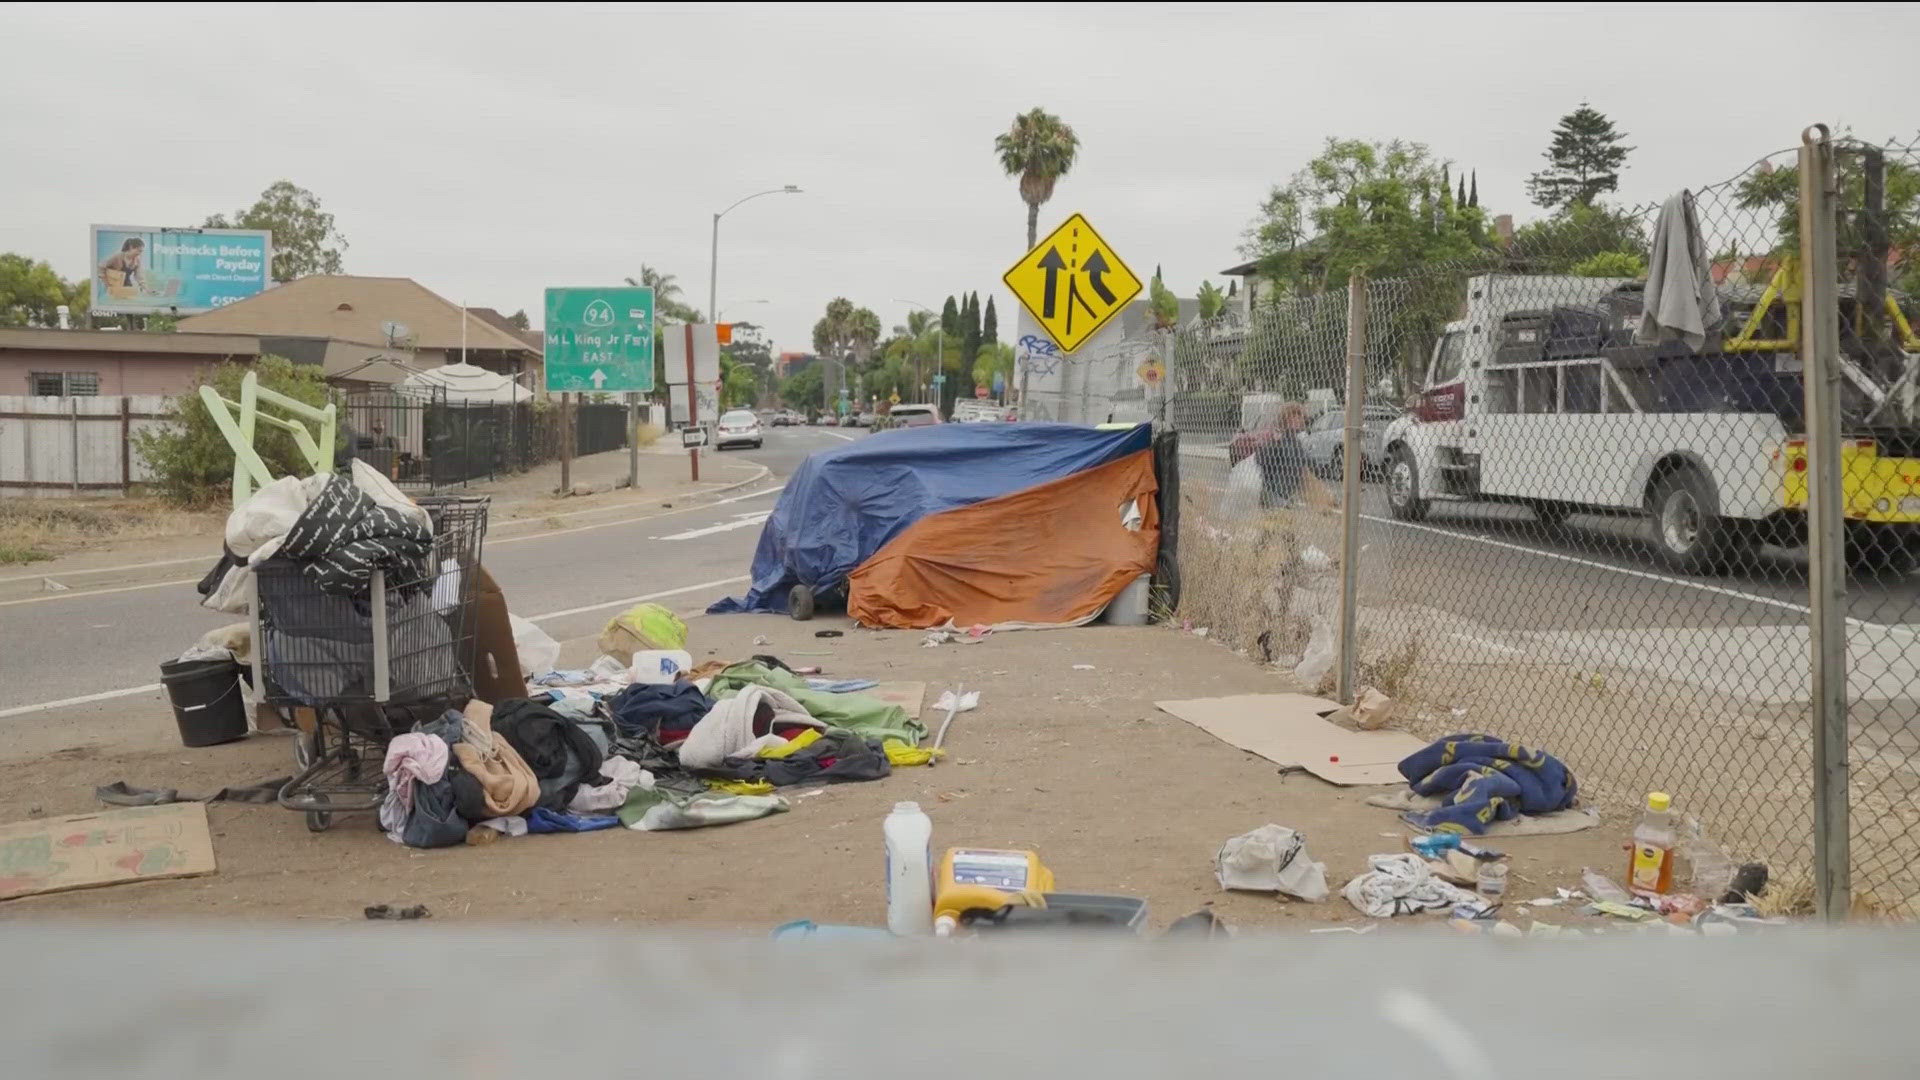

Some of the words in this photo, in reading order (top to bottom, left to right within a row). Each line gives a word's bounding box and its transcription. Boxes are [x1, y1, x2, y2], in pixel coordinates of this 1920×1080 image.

[153, 243, 217, 257] Paychecks
[219, 245, 261, 257] Before
[215, 258, 261, 273] Payday
[588, 308, 609, 322] 94
[574, 334, 601, 348] King
[607, 334, 620, 345] Jr
[624, 334, 649, 347] Fwy
[582, 352, 613, 362] EAST
